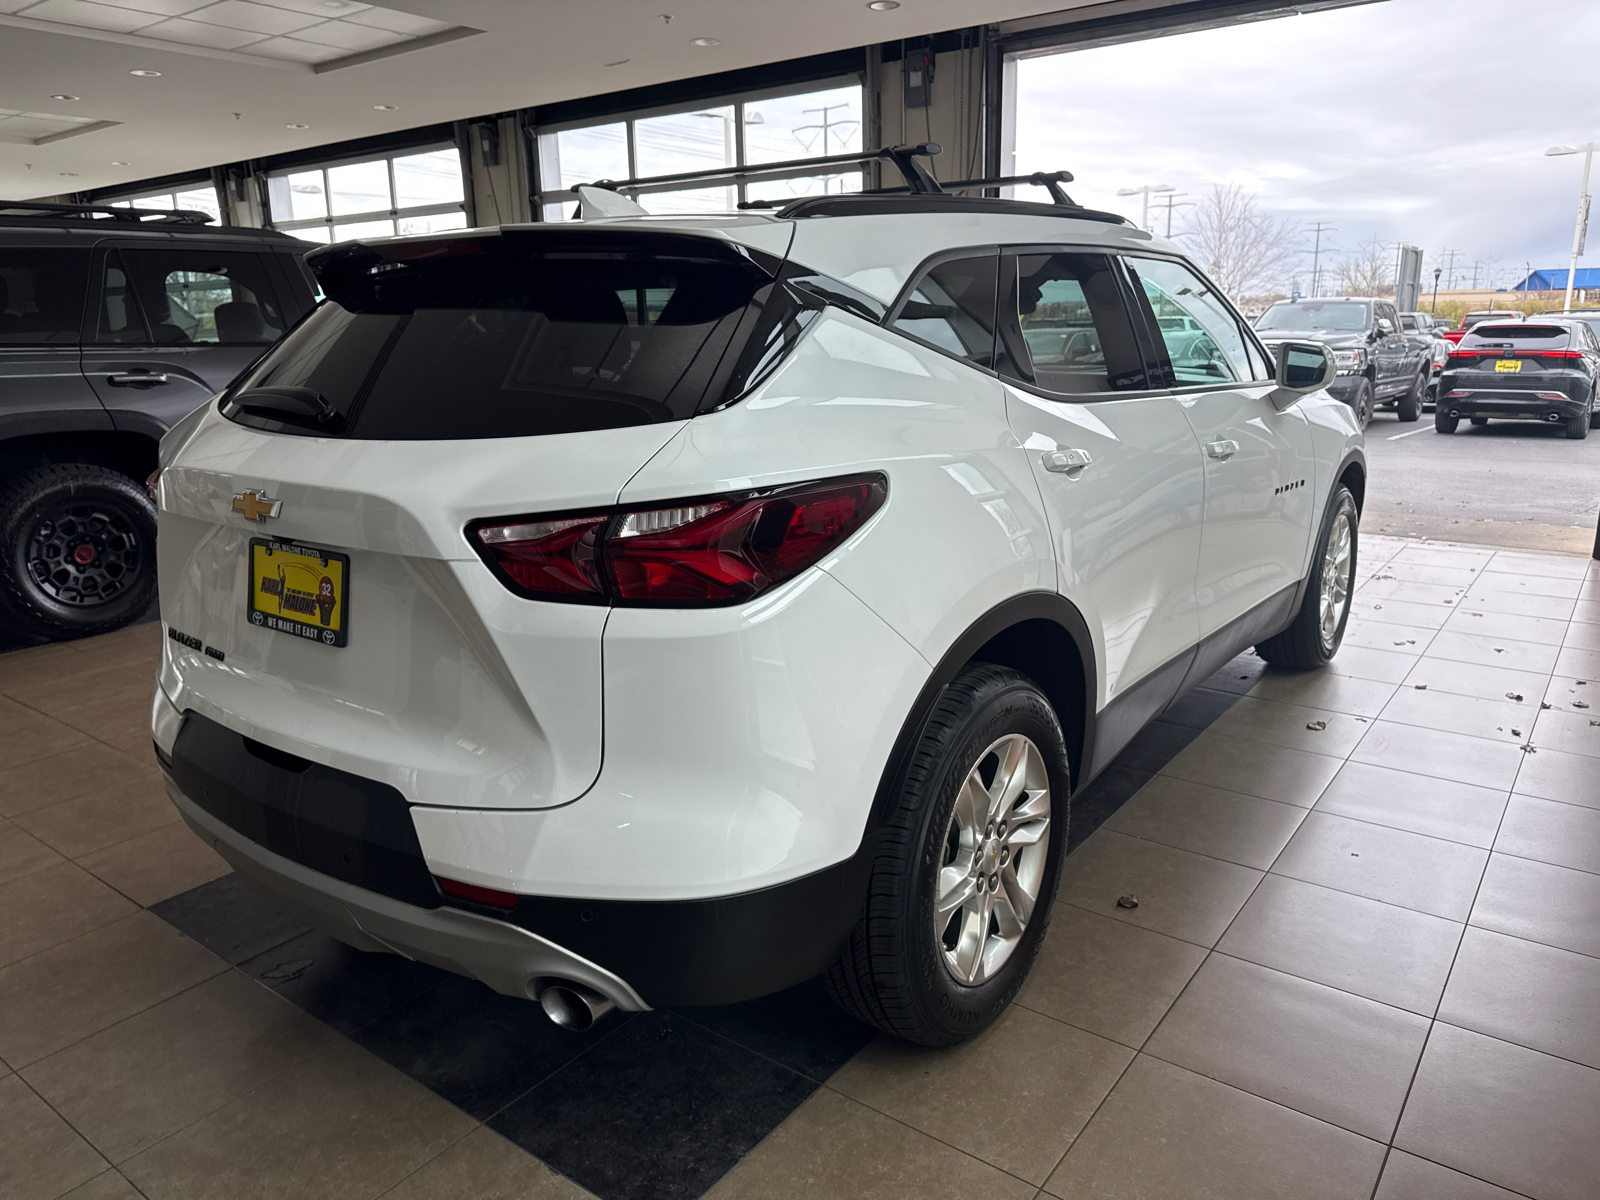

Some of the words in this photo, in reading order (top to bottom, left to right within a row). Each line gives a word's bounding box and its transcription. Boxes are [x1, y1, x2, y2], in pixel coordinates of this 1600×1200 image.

[269, 542, 282, 551] KARL
[281, 544, 302, 555] MALONE
[301, 548, 321, 558] TOYOTA
[260, 576, 281, 597] KARL
[321, 583, 332, 597] 32
[283, 593, 318, 617] MALONE
[267, 617, 277, 628] WE
[278, 619, 294, 632] MAKE
[295, 624, 302, 634] IT
[302, 626, 318, 639] EASY
[939, 993, 981, 1025] KUMHO
